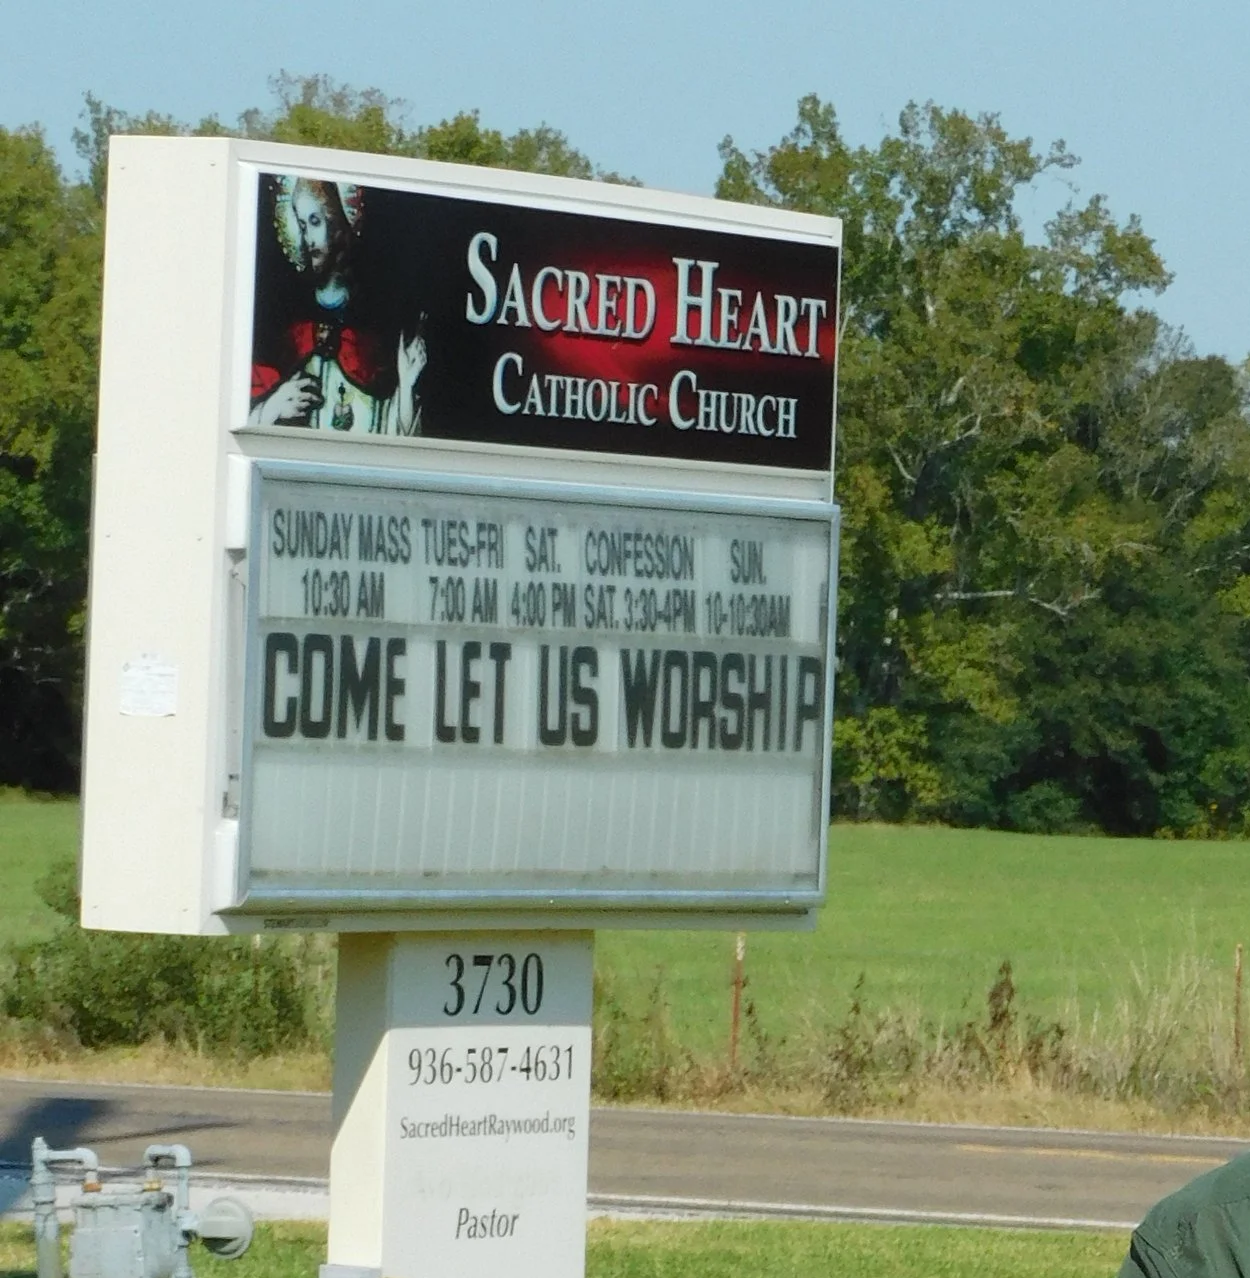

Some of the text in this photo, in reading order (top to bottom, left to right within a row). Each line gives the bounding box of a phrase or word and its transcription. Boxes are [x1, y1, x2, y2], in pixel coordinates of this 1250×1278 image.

[465, 231, 827, 360] SACRED HEART
[492, 352, 799, 439] CATHOLIC CHURCH
[273, 508, 767, 585] SUNDAY MASS TUES-FRI SAT. CONFESSION SUN.
[302, 567, 350, 617] 10:30
[356, 570, 385, 619] AM
[429, 576, 466, 623] 7:00
[471, 577, 498, 624] AM
[511, 581, 546, 628] 4:00
[552, 582, 576, 628] PM
[584, 583, 620, 629] SAT.
[263, 632, 406, 741] COME
[436, 639, 511, 744] LET
[539, 645, 599, 748] US
[619, 648, 822, 752] WORSHIP
[443, 953, 544, 1016] 3730
[408, 1044, 575, 1086] 936-587-4631
[400, 1110, 576, 1143] SacredHeartRaywood.org
[455, 1207, 520, 1240] Pastor
